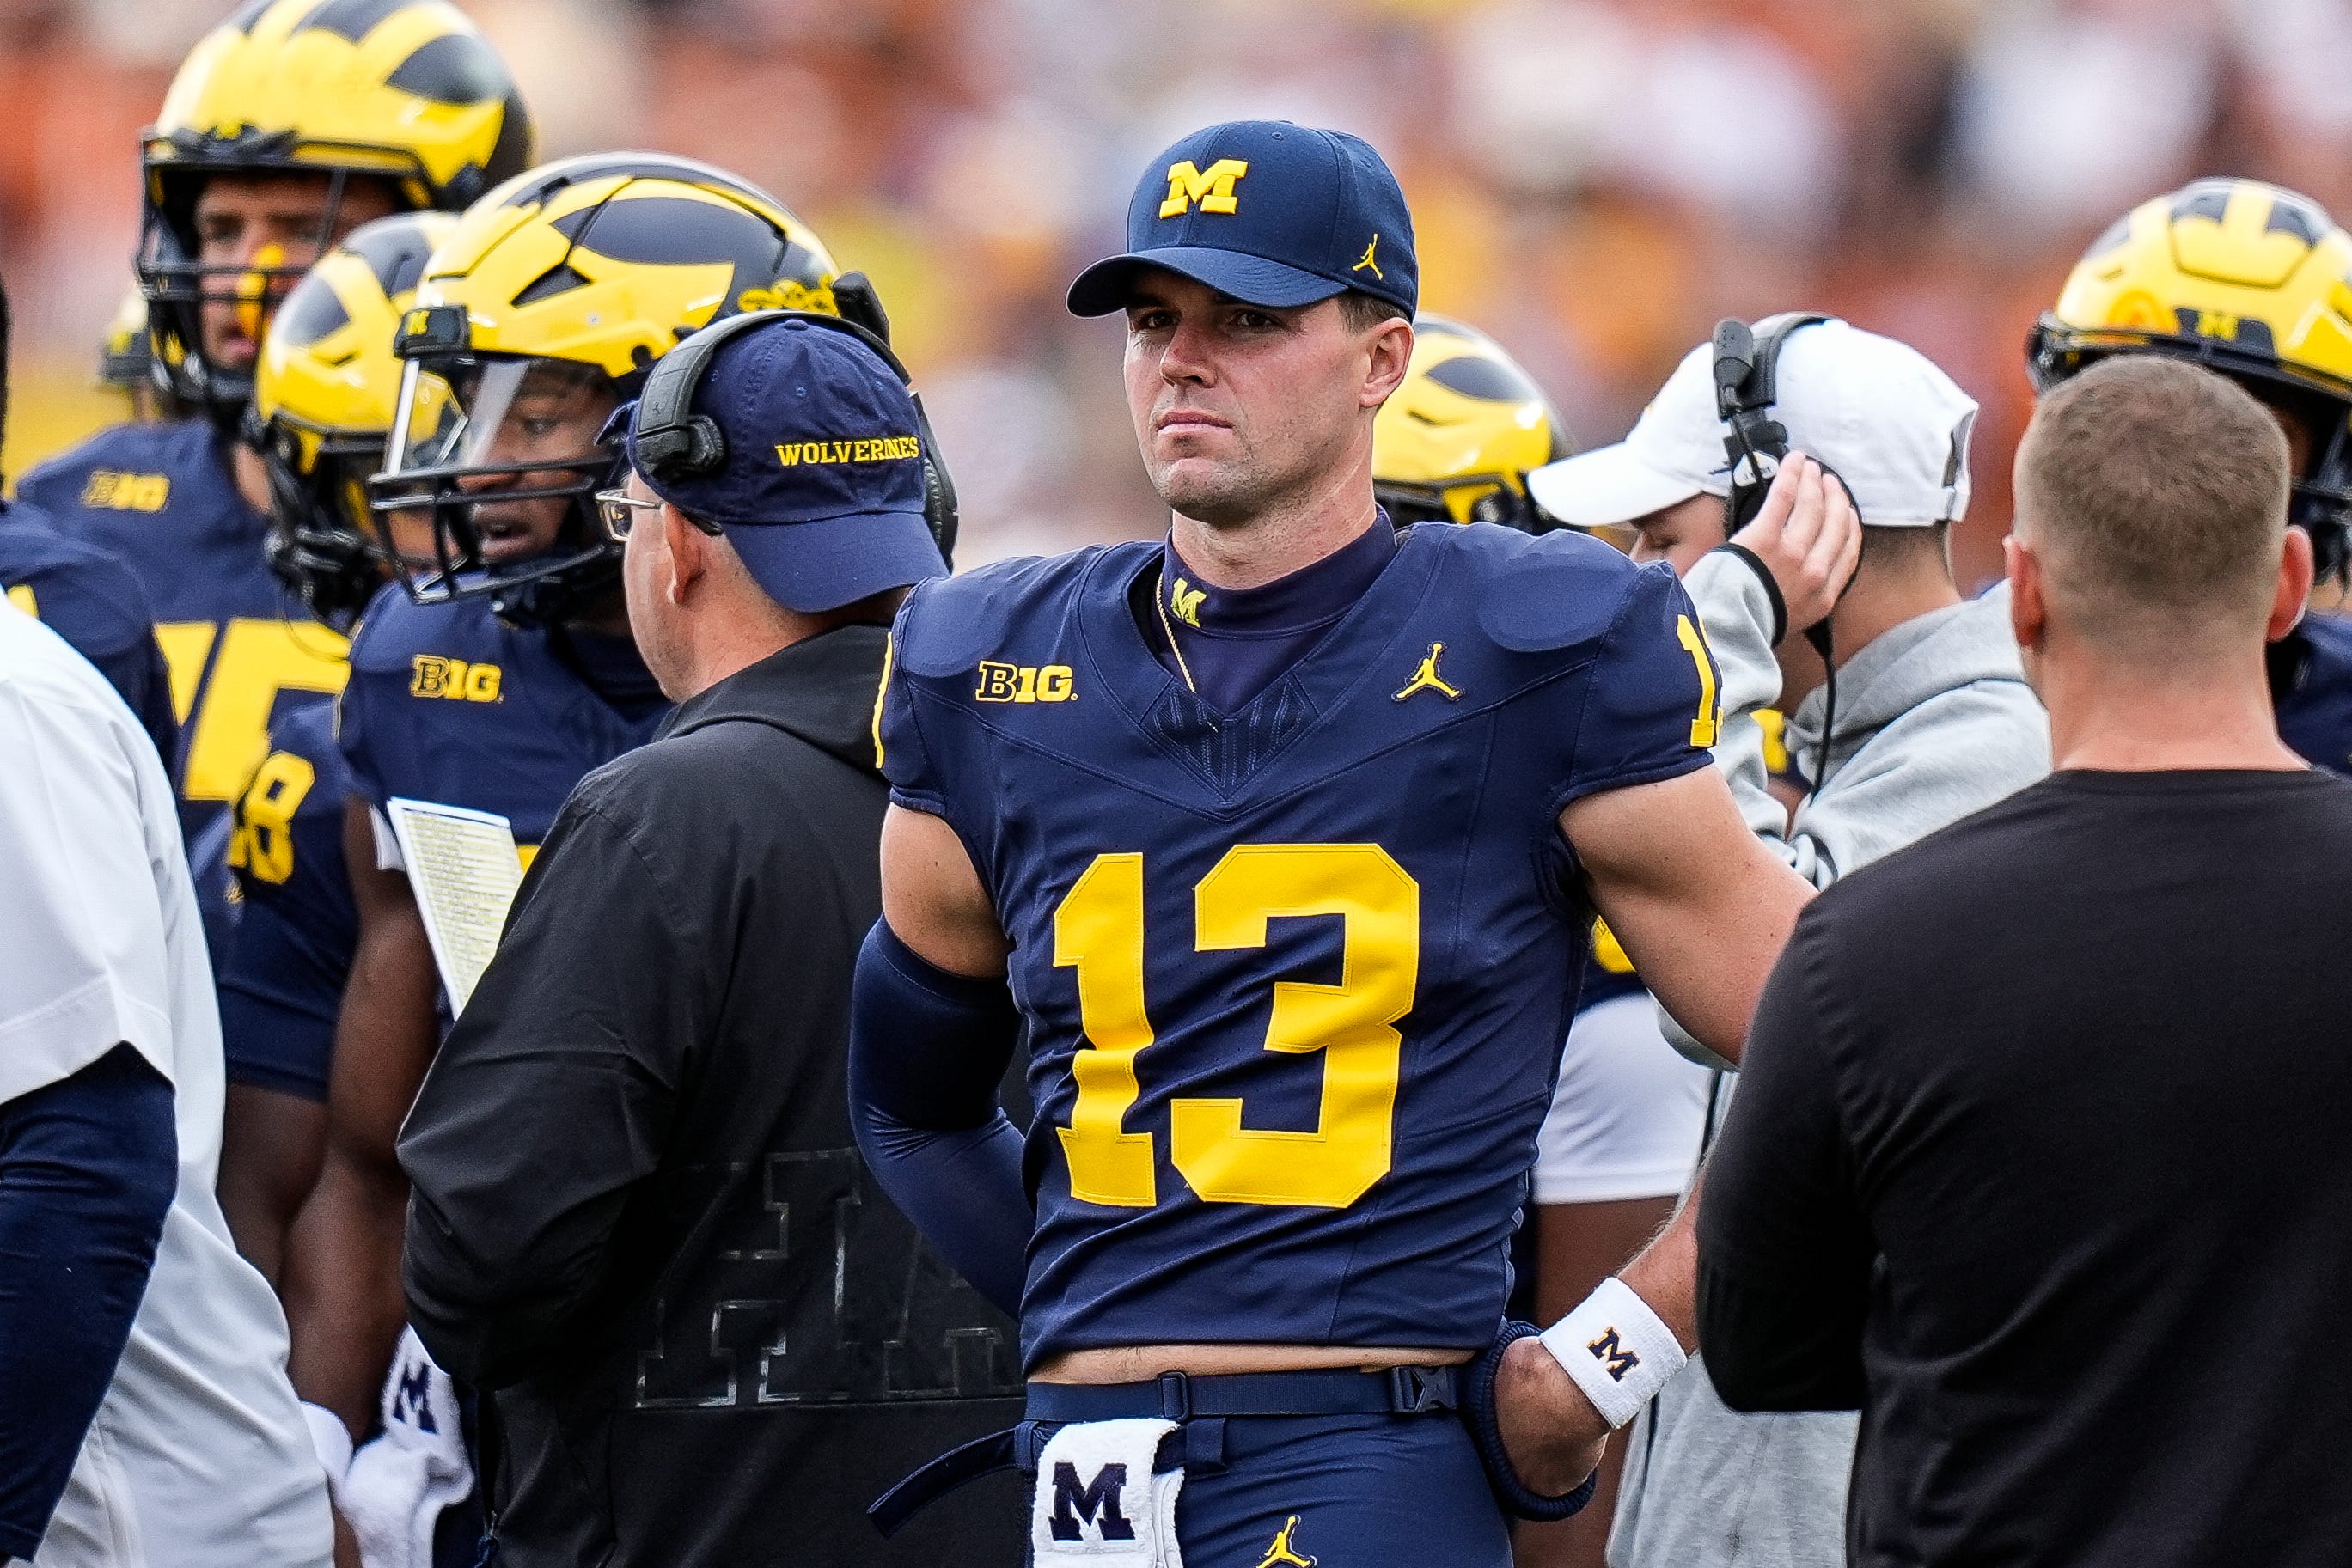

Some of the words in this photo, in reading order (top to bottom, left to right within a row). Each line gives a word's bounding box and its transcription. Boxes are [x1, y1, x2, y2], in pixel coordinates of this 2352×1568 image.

[1158, 158, 1249, 220] M
[774, 436, 919, 467] WOLVERINES
[1170, 577, 1207, 628] M
[1053, 842, 1420, 1208] 13
[1587, 1326, 1640, 1382] M
[392, 1359, 439, 1435] M
[1048, 1461, 1136, 1541] M
